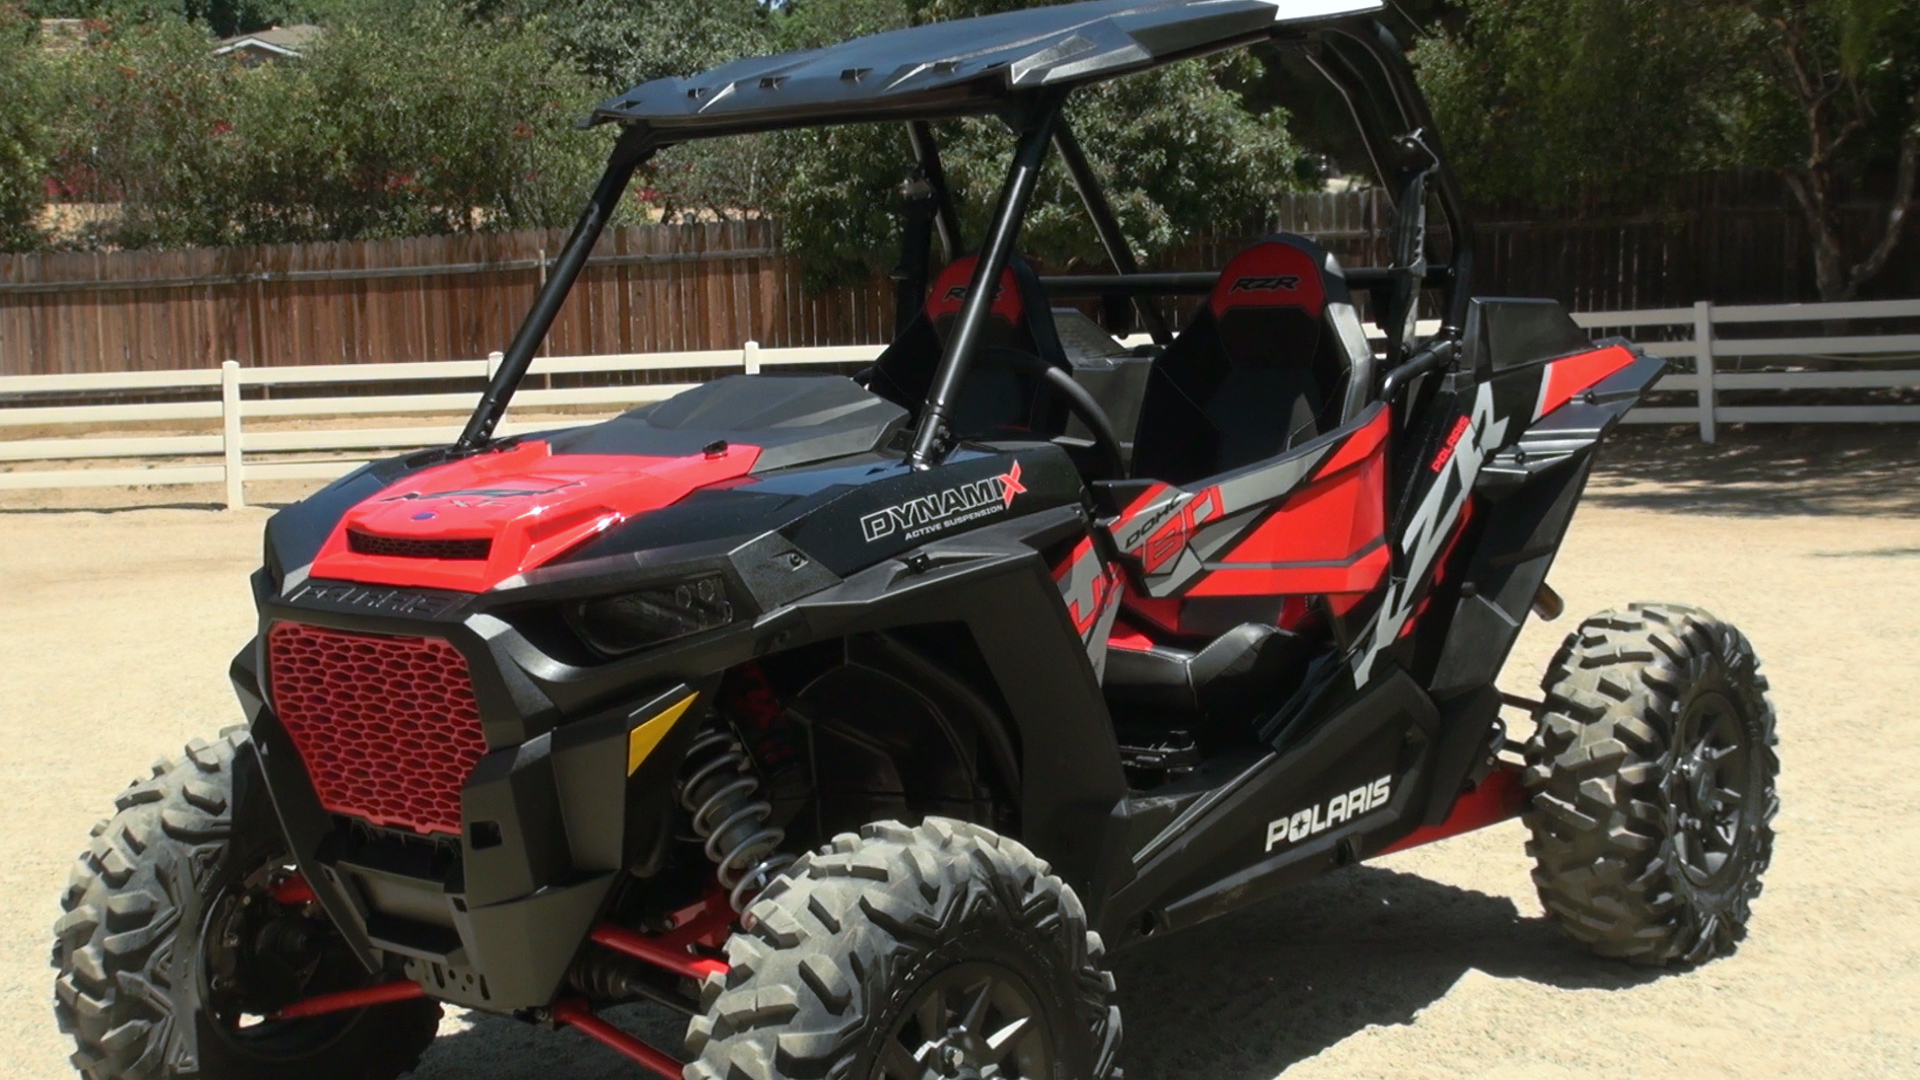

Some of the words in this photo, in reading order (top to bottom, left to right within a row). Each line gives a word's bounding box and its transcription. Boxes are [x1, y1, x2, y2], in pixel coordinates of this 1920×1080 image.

[1228, 275, 1300, 294] RZR
[1431, 415, 1471, 472] POLARIS
[860, 459, 1027, 542] DYNAMIX
[905, 523, 942, 541] ACTIVE
[943, 504, 1003, 528] SUSPENSION
[1125, 493, 1182, 549] DOHC
[1265, 774, 1392, 852] POLARIS
